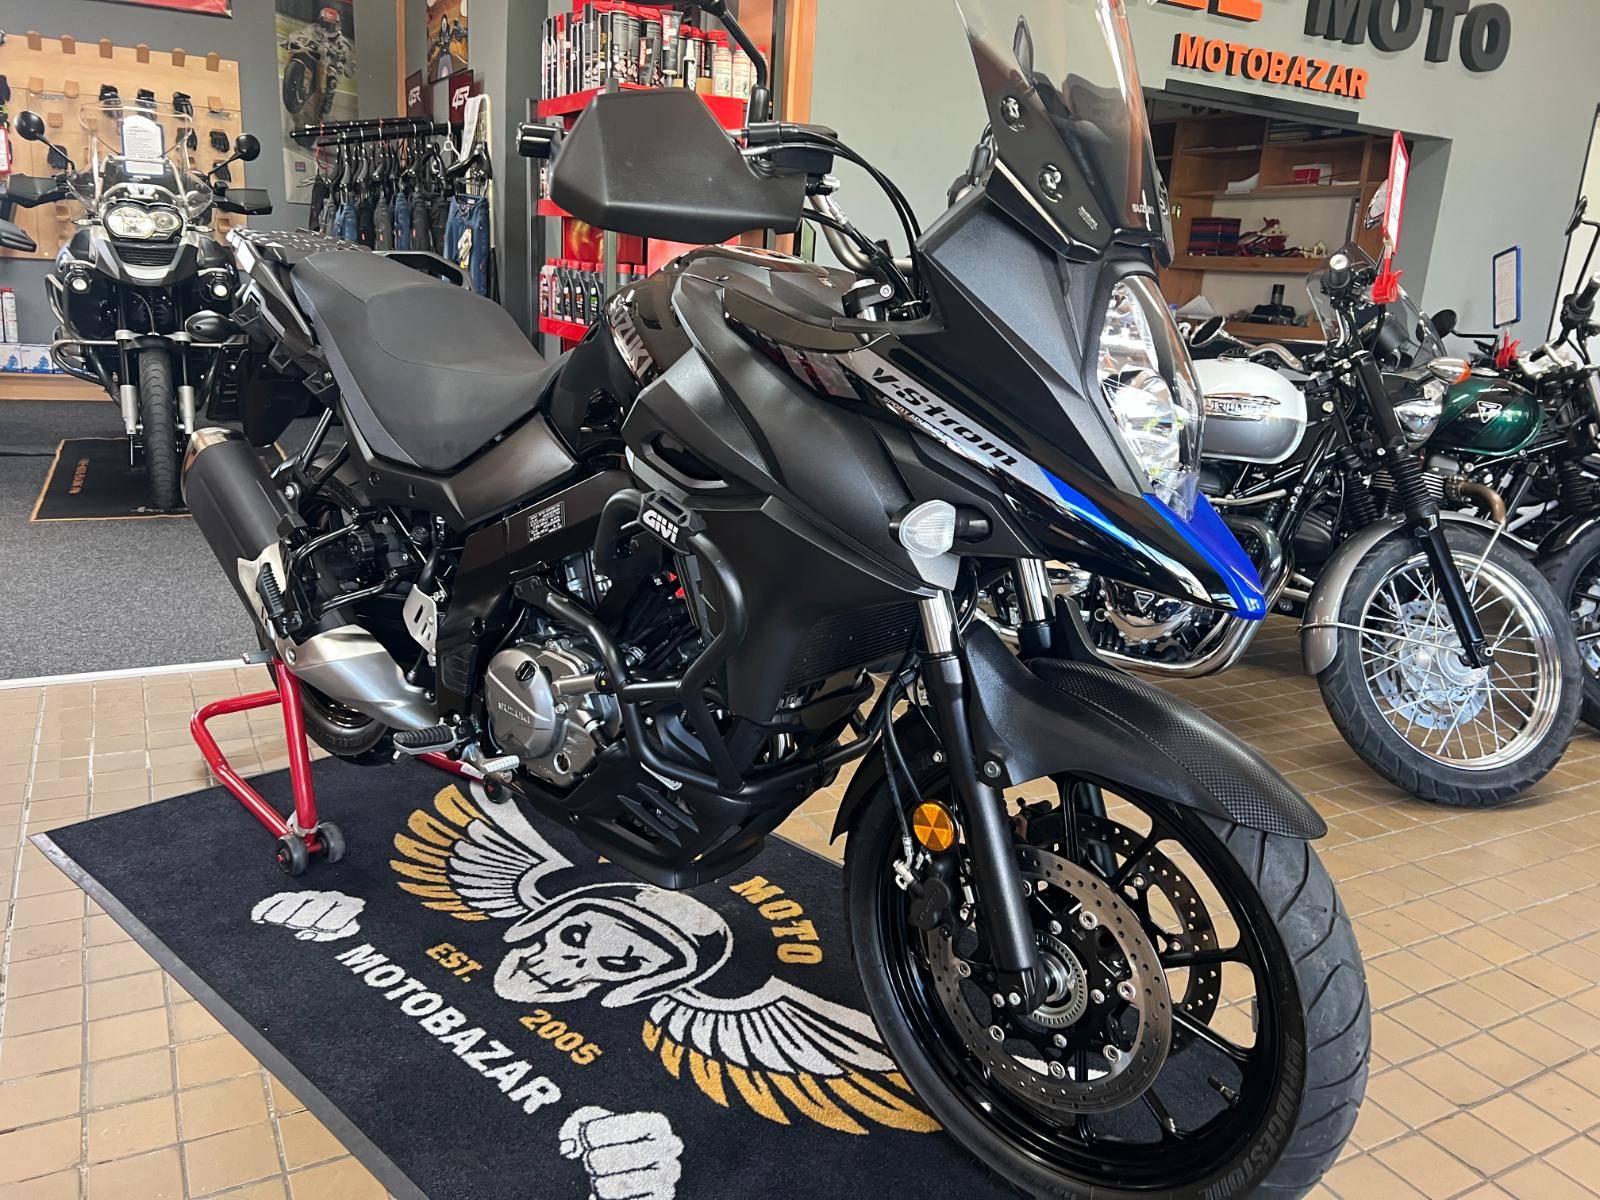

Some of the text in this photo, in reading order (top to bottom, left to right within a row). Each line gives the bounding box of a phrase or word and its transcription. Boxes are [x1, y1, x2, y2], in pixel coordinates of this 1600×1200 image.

[1173, 32, 1368, 99] MOTOBAZAR
[1304, 0, 1511, 73] MOTO
[872, 367, 1018, 467] V-Strom
[643, 510, 679, 544] GIVI
[729, 875, 823, 964] MOTO
[426, 942, 483, 982] EST.
[335, 943, 561, 1114] MOTOBAZAR
[518, 1009, 602, 1065] 2005
